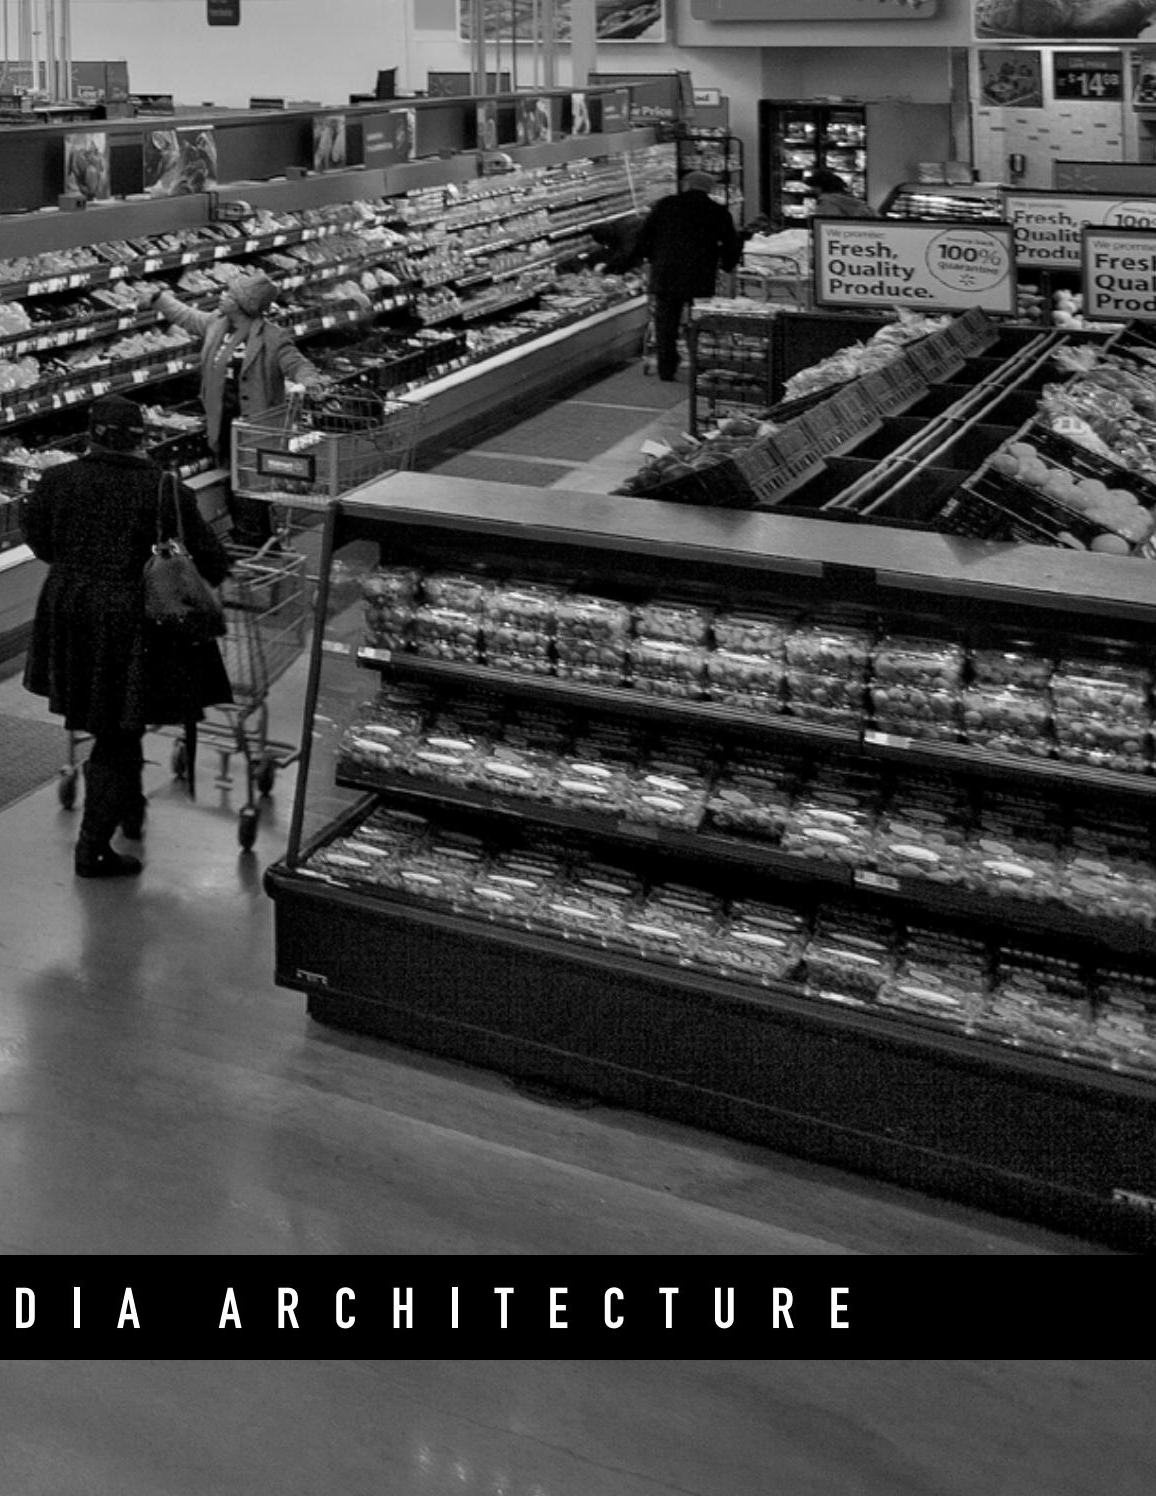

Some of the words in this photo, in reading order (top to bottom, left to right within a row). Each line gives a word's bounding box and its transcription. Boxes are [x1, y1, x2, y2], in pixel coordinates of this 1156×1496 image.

[1014, 210, 1077, 228] Fresh,
[1114, 213, 1156, 227] 100
[828, 240, 898, 260] Fresh,
[938, 244, 1001, 267] 100%
[828, 260, 915, 282] Quality
[829, 279, 935, 299] Produce.
